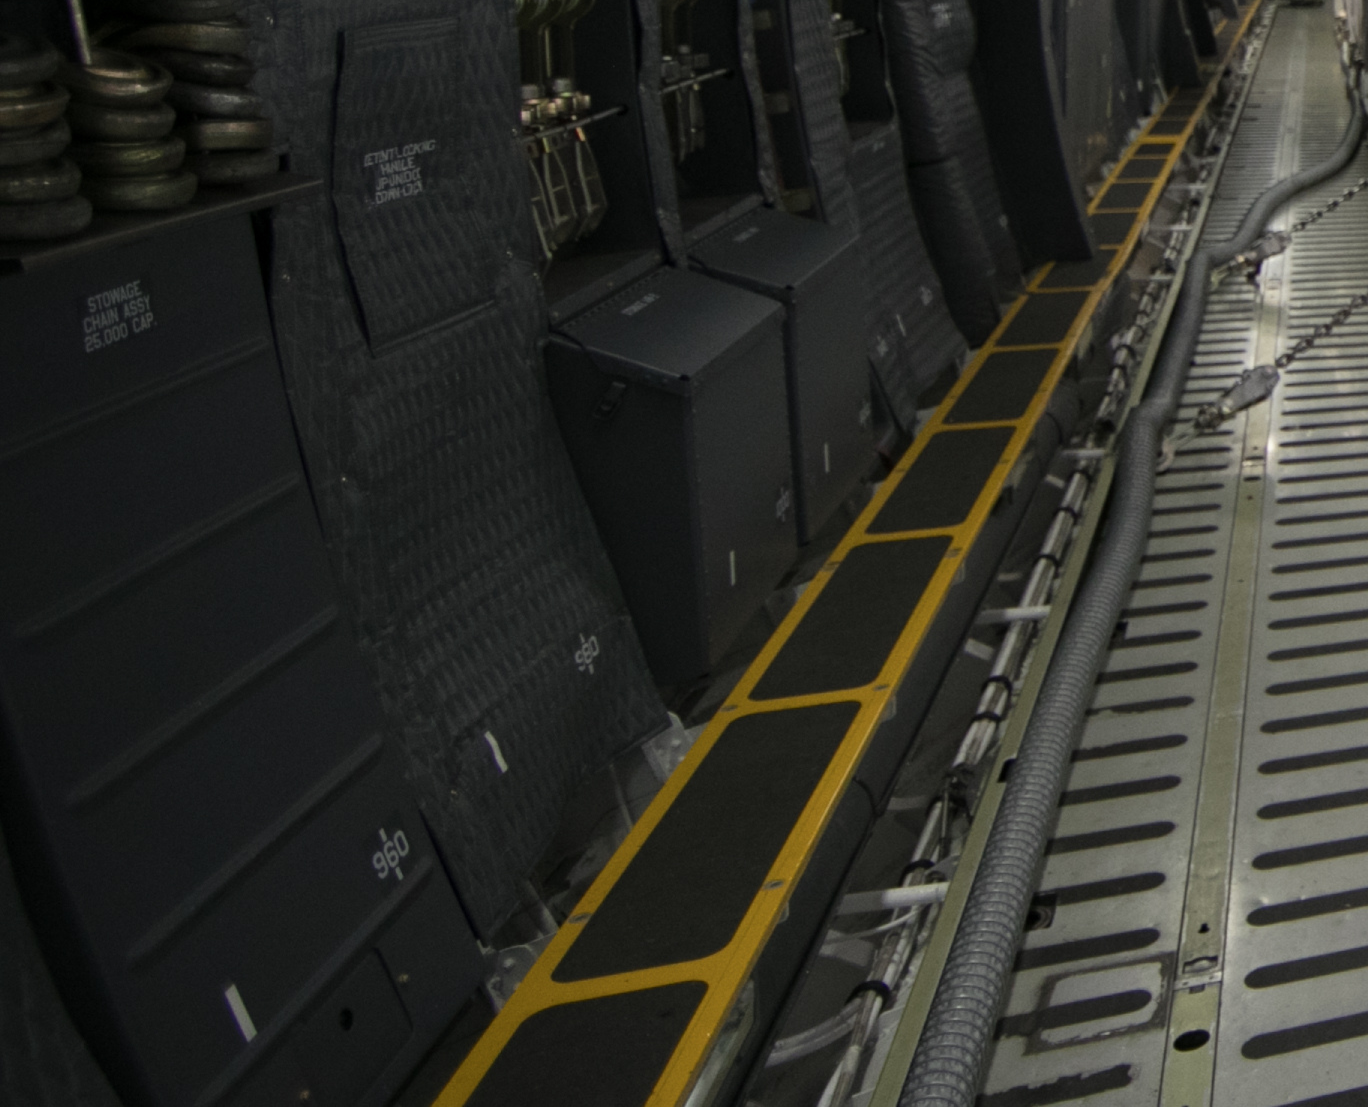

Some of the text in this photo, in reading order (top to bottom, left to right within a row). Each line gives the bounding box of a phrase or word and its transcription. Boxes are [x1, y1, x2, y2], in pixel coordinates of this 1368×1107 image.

[83, 293, 151, 334] CHAIN ASSY
[87, 279, 143, 313] STOWAGE
[132, 311, 158, 334] CAP.
[574, 634, 600, 672] 980
[372, 829, 410, 880] 960
